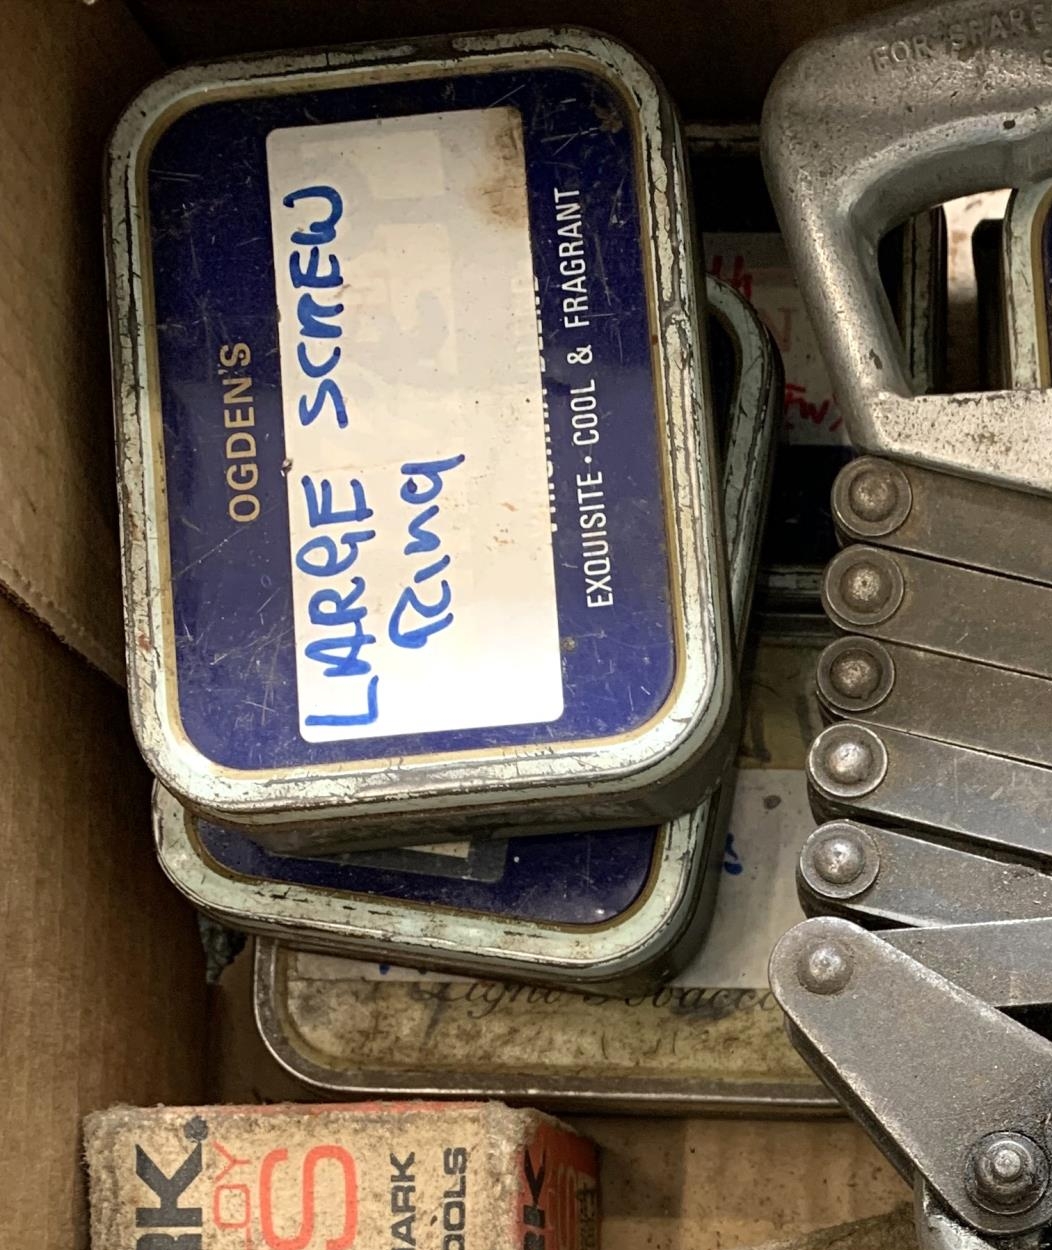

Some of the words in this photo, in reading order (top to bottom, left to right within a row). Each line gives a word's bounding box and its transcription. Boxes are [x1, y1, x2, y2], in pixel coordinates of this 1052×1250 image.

[283, 184, 349, 430] SCREW
[554, 186, 592, 330] FRAGRANT
[566, 343, 594, 366] &
[570, 377, 600, 449] COOL
[218, 341, 260, 524] OGDEN'S
[294, 474, 379, 728] LARGE
[585, 469, 615, 610] EXQUISITE
